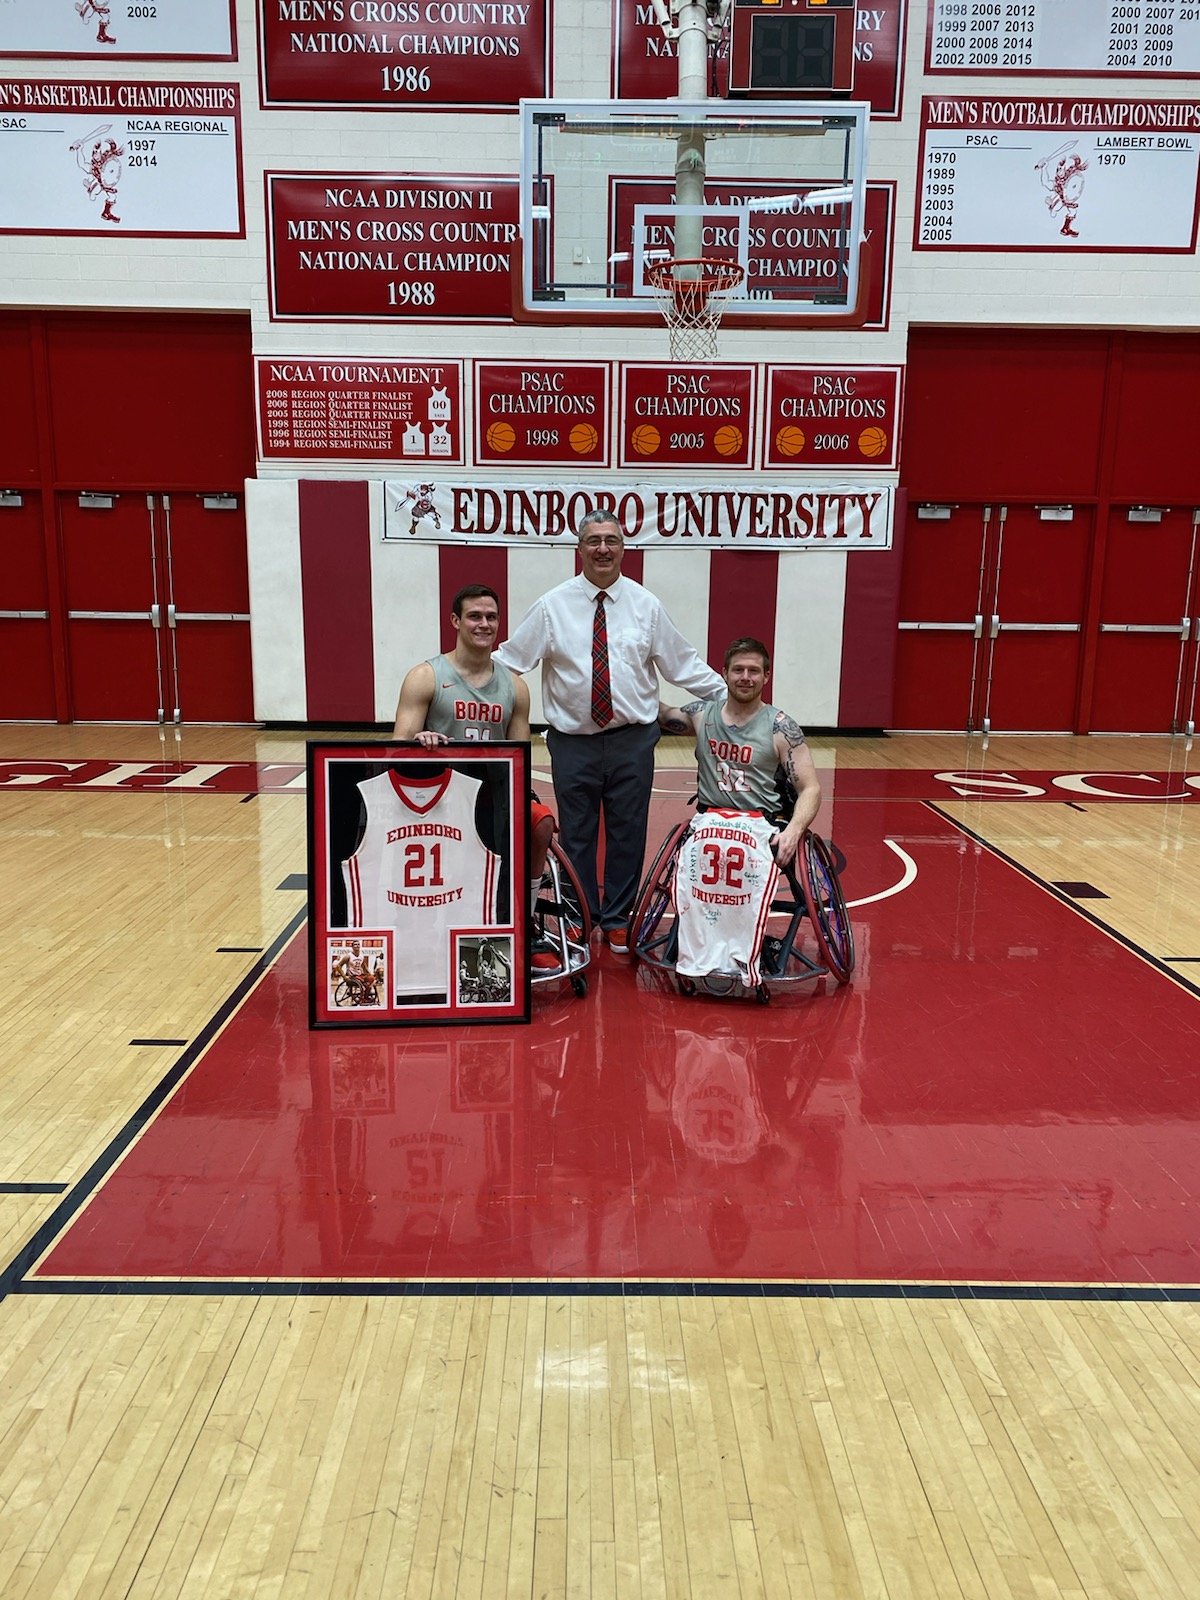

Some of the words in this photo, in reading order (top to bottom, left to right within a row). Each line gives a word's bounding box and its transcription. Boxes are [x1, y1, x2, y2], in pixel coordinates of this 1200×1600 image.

[127, 6, 157, 18] 2002
[278, 1, 345, 22] MEN'S
[350, 2, 419, 24] CROSS
[425, 3, 530, 26] COUNTRY
[938, 5, 968, 16] 1998
[971, 4, 1001, 16] 2006
[1005, 5, 1036, 17] 2012
[1111, 6, 1141, 18] 2000
[1145, 7, 1175, 20] 2007
[937, 21, 967, 32] 1999
[970, 20, 1000, 32] 2007
[1004, 21, 1034, 33] 2013
[1110, 22, 1139, 35] 2001
[1144, 23, 1174, 35] 2008
[290, 33, 394, 54] NATIONAL
[399, 34, 520, 56] CHAMPIONS
[936, 37, 966, 49] 2000
[969, 37, 999, 49] 2008
[1003, 38, 1033, 49] 2014
[1108, 39, 1138, 51] 2003
[1144, 39, 1173, 51] 2009
[935, 53, 965, 65] 2002
[968, 53, 998, 65] 2009
[1002, 54, 1032, 65] 2015
[1107, 54, 1137, 66] 2004
[1142, 54, 1172, 66] 2010
[381, 65, 431, 92] 1986
[23, 84, 115, 107] BASKETBALL
[117, 86, 236, 109] CHAMPIONSHIPS
[927, 101, 978, 124] MEN'S
[981, 102, 1068, 126] FOOTBALL
[1070, 103, 1200, 127] CHAMPIONSHIPS
[0, 118, 27, 129] SAC
[127, 121, 162, 131] NCAA
[164, 121, 228, 133] REGIONAL
[127, 140, 156, 151] 1997
[966, 135, 998, 146] PSAC
[1096, 136, 1155, 148] LAMBERT
[1157, 138, 1192, 149] BOWL
[128, 156, 158, 167] 2014
[927, 153, 957, 164] 1970
[1096, 155, 1126, 166] 1970
[926, 169, 956, 180] 1989
[925, 184, 955, 196] 1995
[325, 189, 380, 208] NCAA
[384, 190, 473, 209] DIVISION
[477, 191, 493, 210] II
[924, 200, 954, 211] 2003
[923, 216, 953, 227] 2004
[287, 220, 351, 241] MEN'S
[356, 221, 424, 243] CROSS
[429, 223, 522, 243] COUNTR
[922, 230, 952, 241] 2005
[299, 251, 399, 271] NATIONAL
[387, 281, 436, 306] 1988
[270, 365, 316, 382] NCAA
[319, 366, 444, 384] TOURNAMENT
[521, 372, 565, 391] PSAC
[667, 374, 710, 394] PSAC
[812, 376, 857, 396] PSAC
[291, 391, 326, 399] REGION
[328, 391, 370, 401] QUARTER
[372, 391, 413, 401] FINALIST
[291, 400, 326, 409] REGION
[328, 401, 370, 411] QUARTER
[372, 401, 413, 411] FINALIST
[432, 400, 446, 410] 00
[489, 394, 596, 415] CHAMPIONS
[634, 396, 741, 417] CHAMPIONS
[780, 398, 886, 418] CHAMPIONS
[292, 410, 327, 419] REGION
[329, 410, 371, 420] QUARTER
[373, 411, 414, 420] FINALIST
[292, 420, 327, 429] REGION
[328, 420, 392, 430] SEMI-FINALIST
[293, 430, 327, 438] REGION
[329, 430, 392, 439] SEMI-FINALIST
[411, 435, 416, 444] 1
[433, 435, 447, 445] 32
[526, 429, 559, 446] 1998
[670, 432, 705, 449] 2005
[294, 440, 328, 448] REGION
[329, 440, 393, 449] SEMI-FINALIST
[814, 434, 850, 450] 2006
[655, 492, 882, 538] UNIVERSITY
[454, 700, 503, 724] BORO
[708, 739, 753, 764] BORO
[717, 761, 752, 793] 32
[386, 824, 462, 844] EDINBORO
[693, 827, 757, 849] EDINBORO
[404, 843, 444, 887] 21
[701, 843, 745, 889] 32
[387, 887, 463, 908] UNIVERSITY
[691, 885, 752, 906] UNIVERSITY
